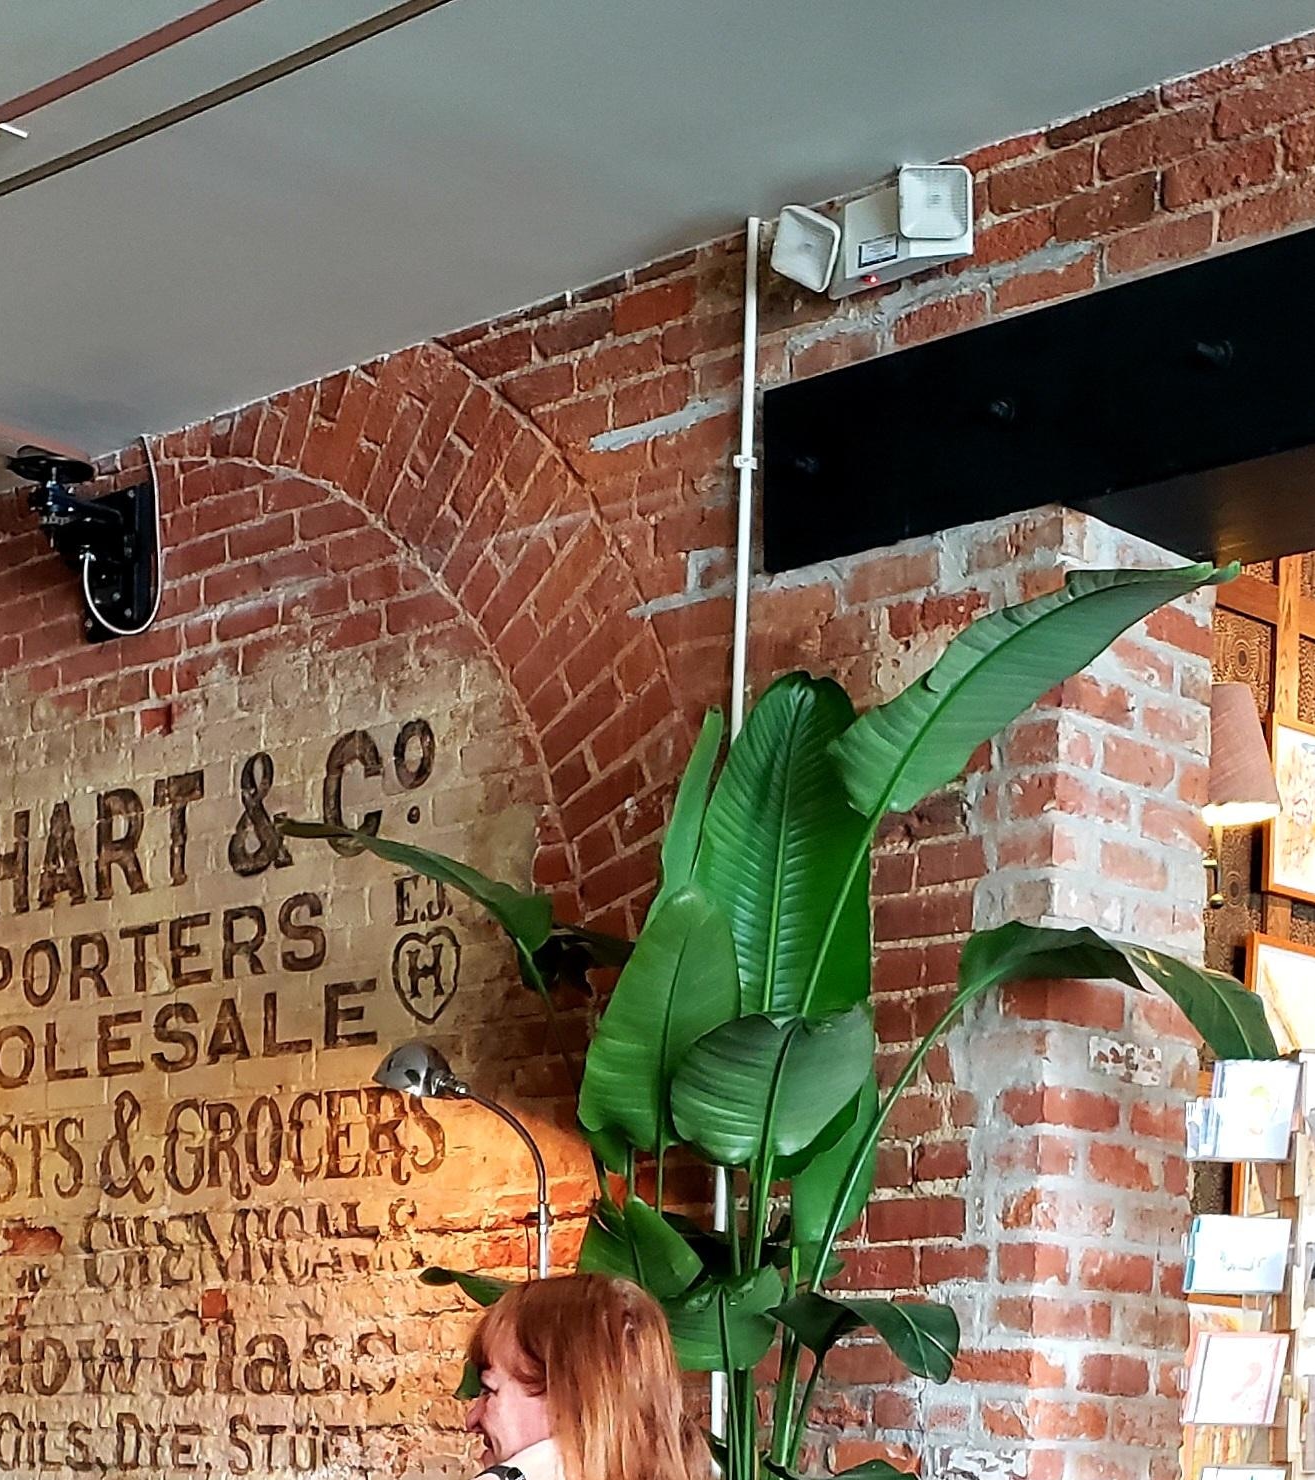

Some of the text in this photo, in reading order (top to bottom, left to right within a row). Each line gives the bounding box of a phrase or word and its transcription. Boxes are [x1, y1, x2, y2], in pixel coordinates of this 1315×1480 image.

[227, 751, 293, 877] &
[100, 1090, 155, 1202] &
[164, 1085, 446, 1199] GROCERS
